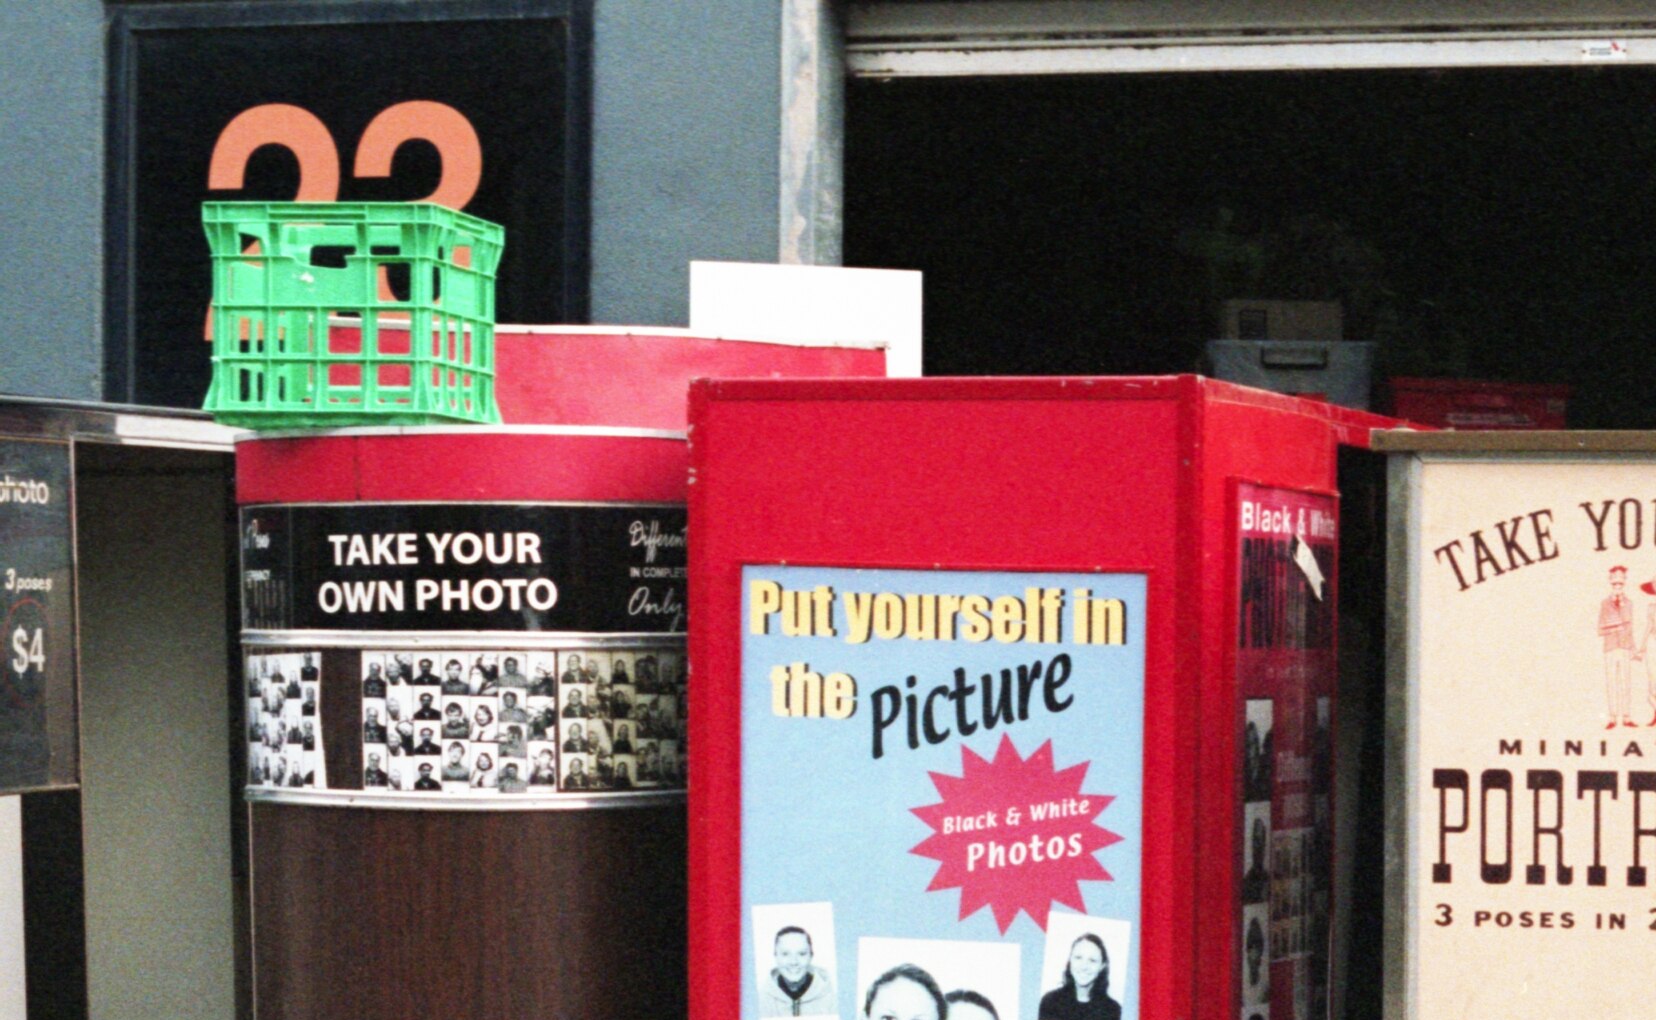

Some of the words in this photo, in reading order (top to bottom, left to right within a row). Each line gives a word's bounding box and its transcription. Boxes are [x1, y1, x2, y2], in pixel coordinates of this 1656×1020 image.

[1241, 501, 1292, 533] Black
[1297, 508, 1306, 535] &
[1310, 509, 1335, 537] White
[329, 533, 417, 566] TAKE
[425, 531, 541, 566] YOUR
[1433, 509, 1561, 592] TAKE
[5, 568, 16, 590] 3
[16, 577, 52, 593] poses
[630, 567, 640, 578] IN
[319, 581, 404, 613] OWN
[416, 577, 557, 611] PHOTO
[628, 587, 684, 632] Only
[750, 579, 836, 637] Put
[844, 586, 1065, 646] yourself
[1074, 588, 1127, 645] in
[12, 625, 45, 679] $4
[771, 662, 858, 719] the
[942, 811, 997, 835] Black
[1006, 806, 1022, 826] &
[1029, 797, 1090, 821] White
[966, 832, 1083, 871] Photos
[1434, 904, 1453, 927] 3
[1475, 911, 1575, 930] POSES
[1597, 912, 1625, 931] IN
